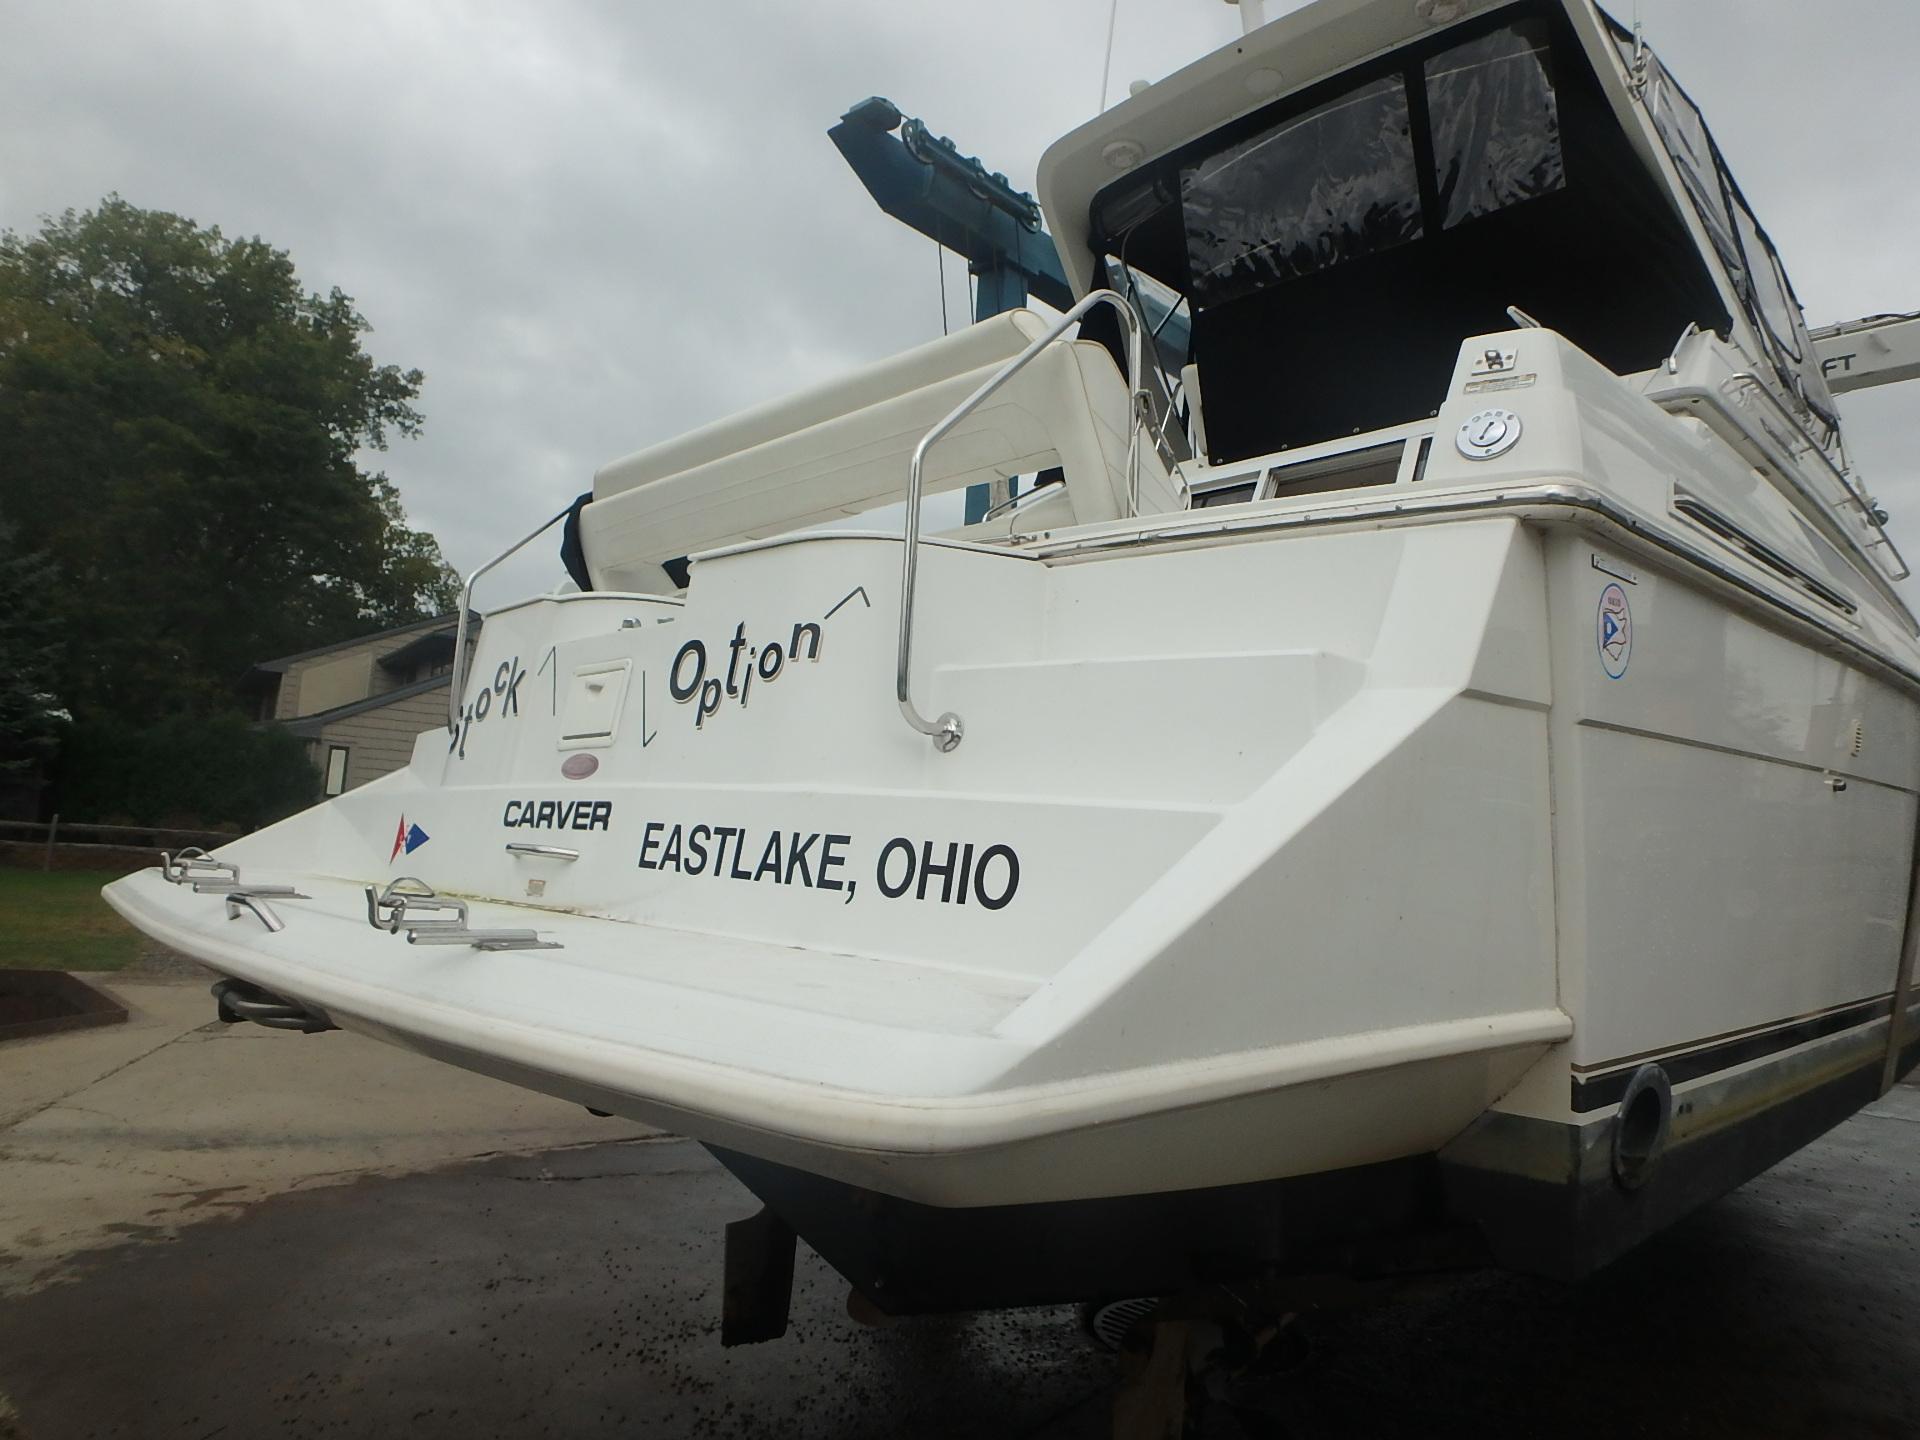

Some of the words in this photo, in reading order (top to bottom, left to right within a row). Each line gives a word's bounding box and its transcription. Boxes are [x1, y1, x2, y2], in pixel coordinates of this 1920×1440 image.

[669, 621, 822, 730] Option
[503, 800, 613, 831] CARVER
[638, 822, 857, 904] EASTLAKE,
[876, 837, 1020, 910] OHIO
